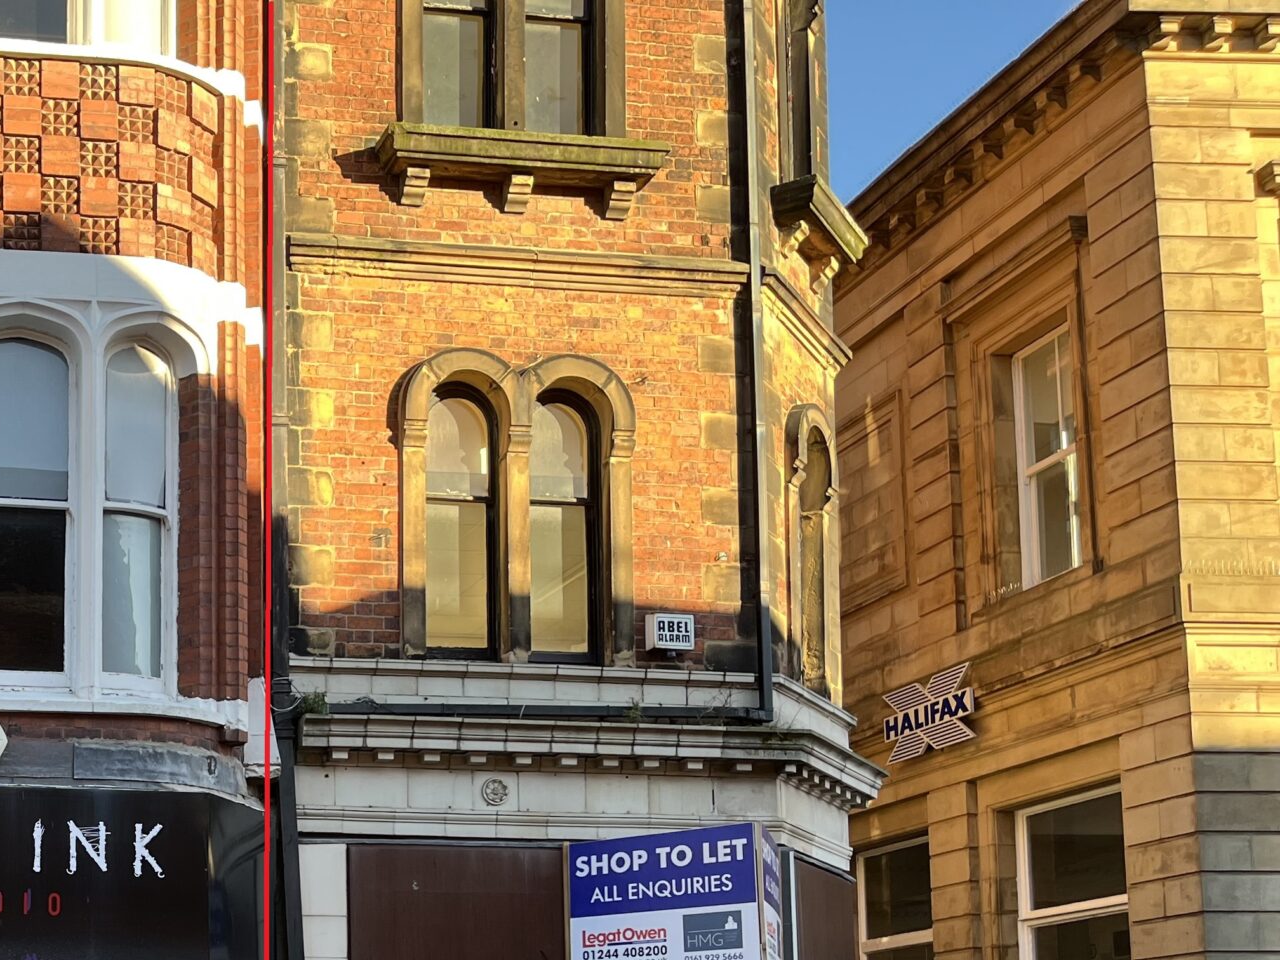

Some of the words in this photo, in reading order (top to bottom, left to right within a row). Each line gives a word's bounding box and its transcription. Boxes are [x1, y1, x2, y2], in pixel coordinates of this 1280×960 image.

[658, 620, 690, 633] ABEL
[658, 633, 690, 643] ALARM
[885, 690, 969, 741] HALIFAX
[32, 818, 166, 879] INK
[575, 849, 648, 878] SHOP
[656, 844, 693, 869] TO
[702, 838, 747, 864] LET
[590, 885, 622, 903] ALL
[628, 873, 733, 899] ENQUIRIES
[687, 932, 724, 948] HMG
[582, 949, 619, 960] 01244
[622, 945, 668, 959] 408200
[722, 951, 744, 960] 5666
